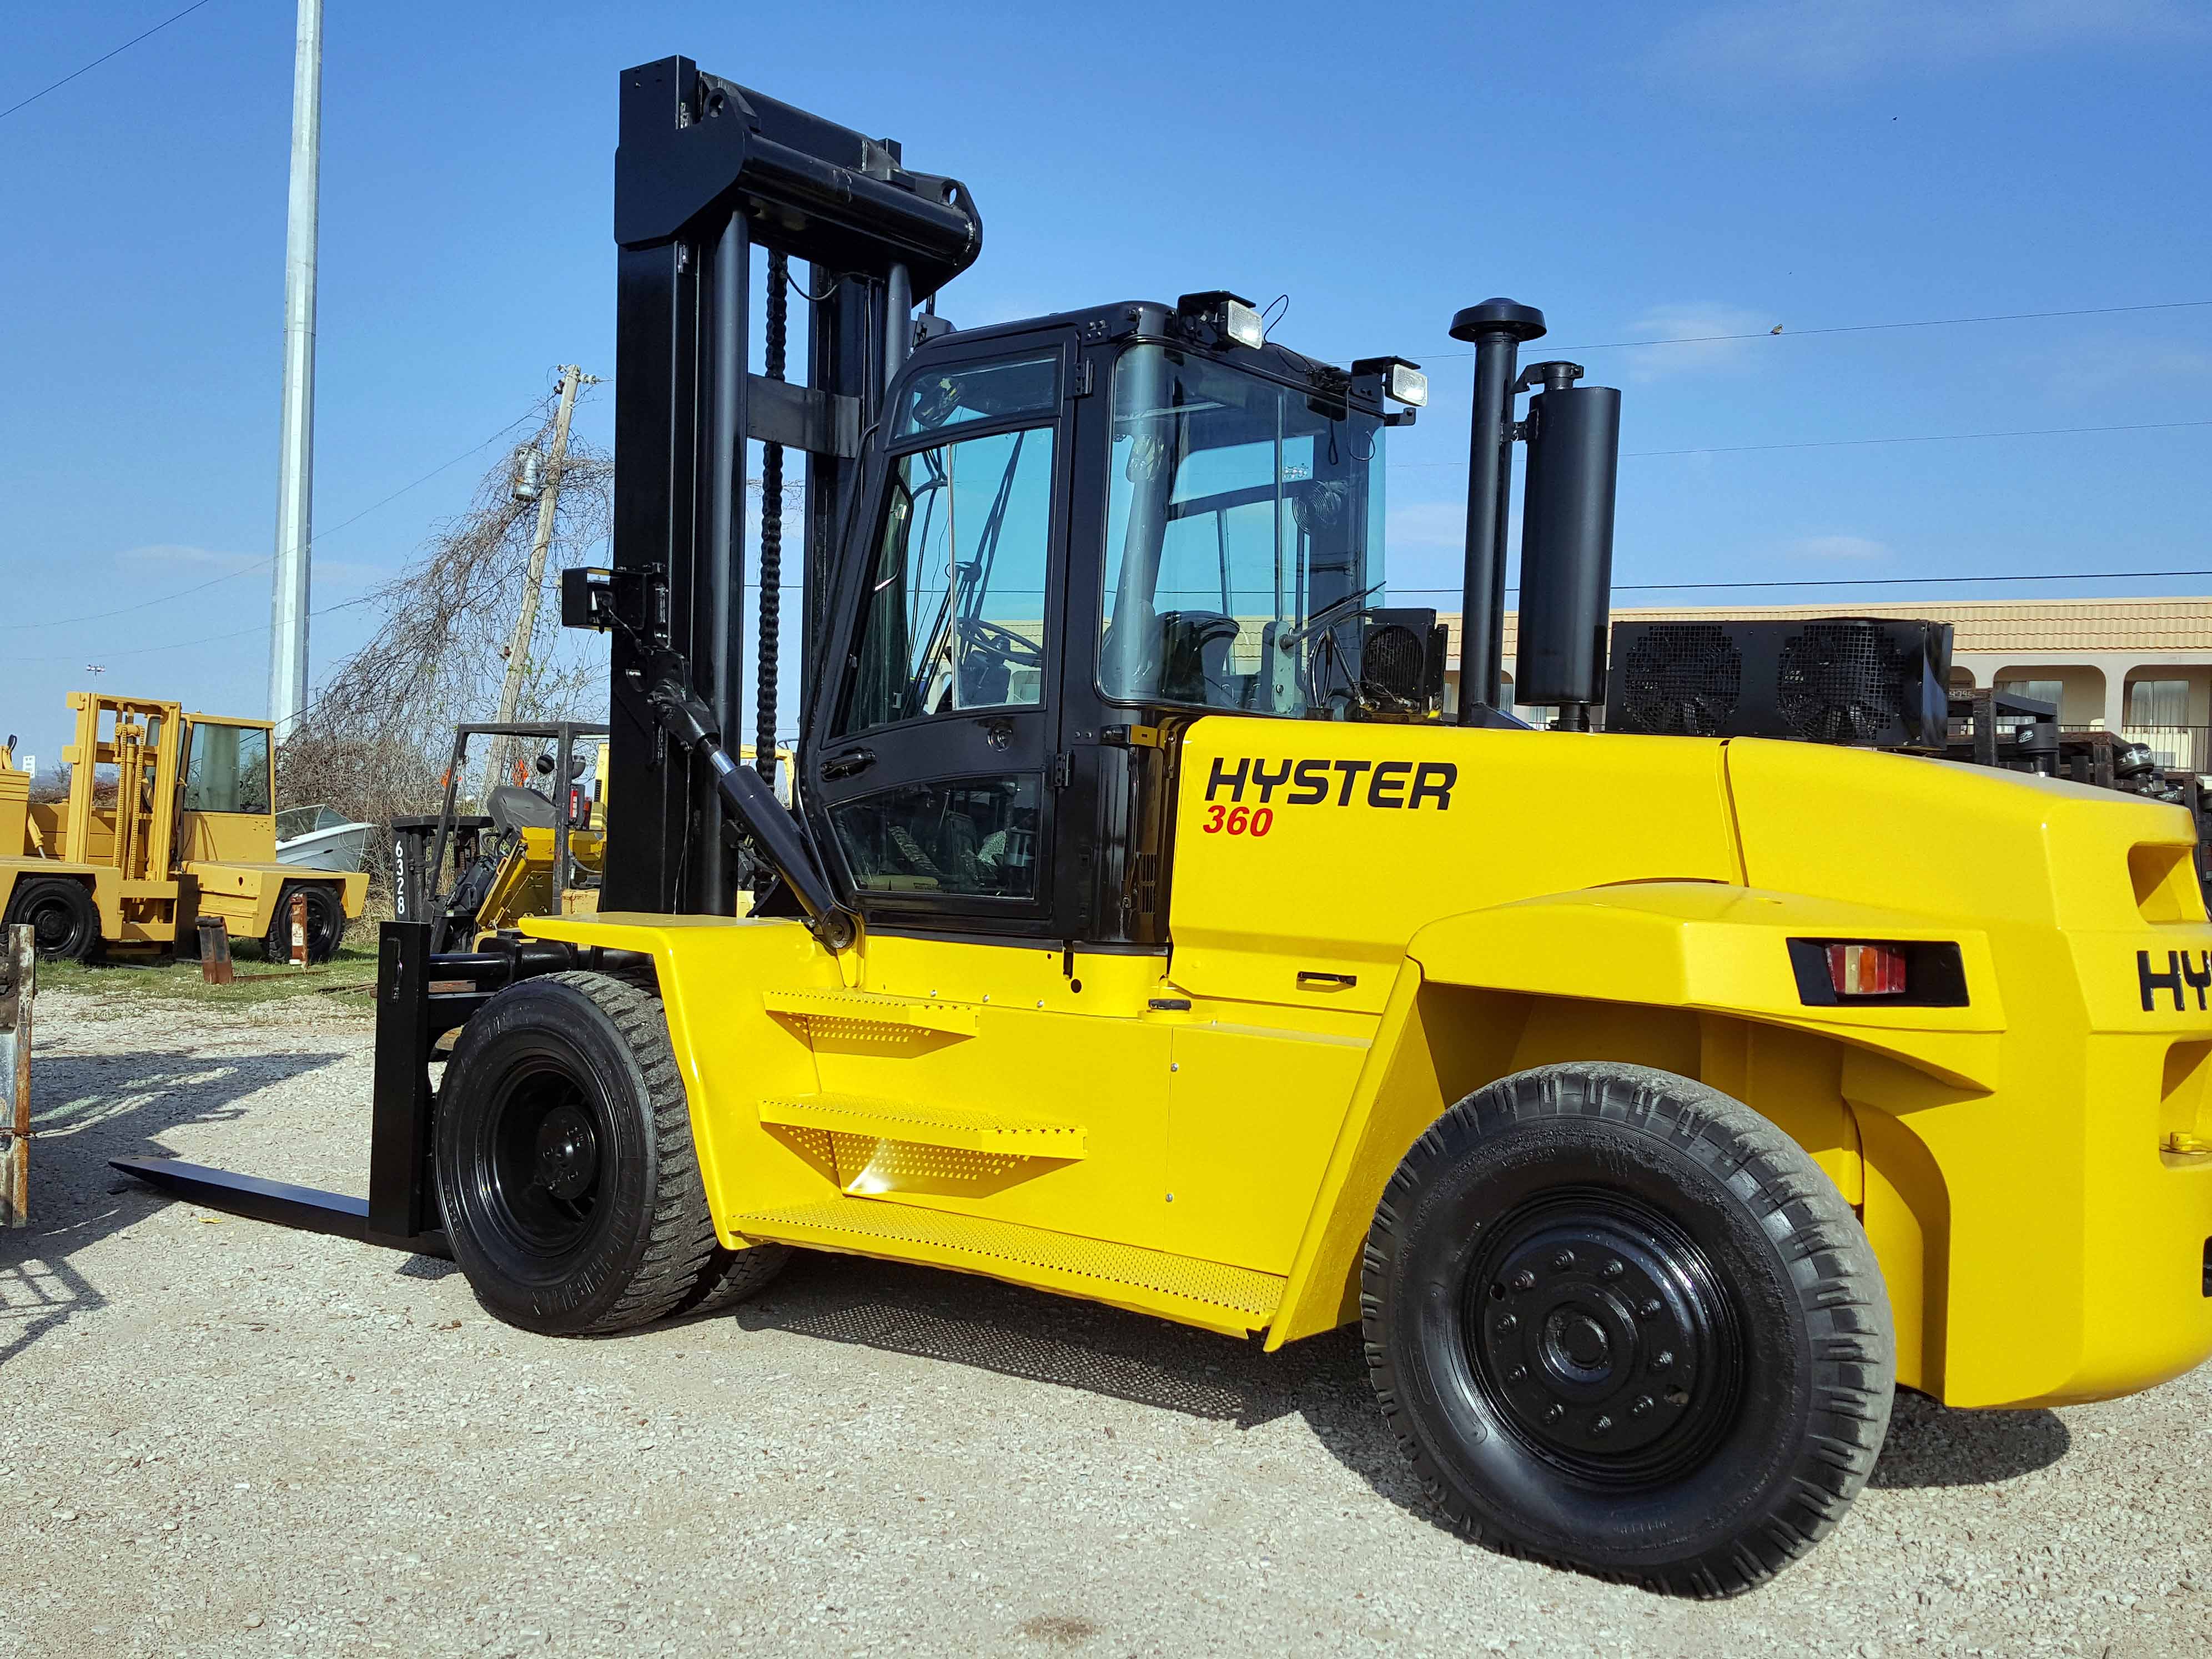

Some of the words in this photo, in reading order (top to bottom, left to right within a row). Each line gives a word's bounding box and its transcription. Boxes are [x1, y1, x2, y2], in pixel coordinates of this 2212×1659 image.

[1204, 757, 1457, 811] HYSTER
[1203, 805, 1273, 837] 360
[395, 840, 405, 914] 6328
[2136, 950, 2212, 1012] HY
